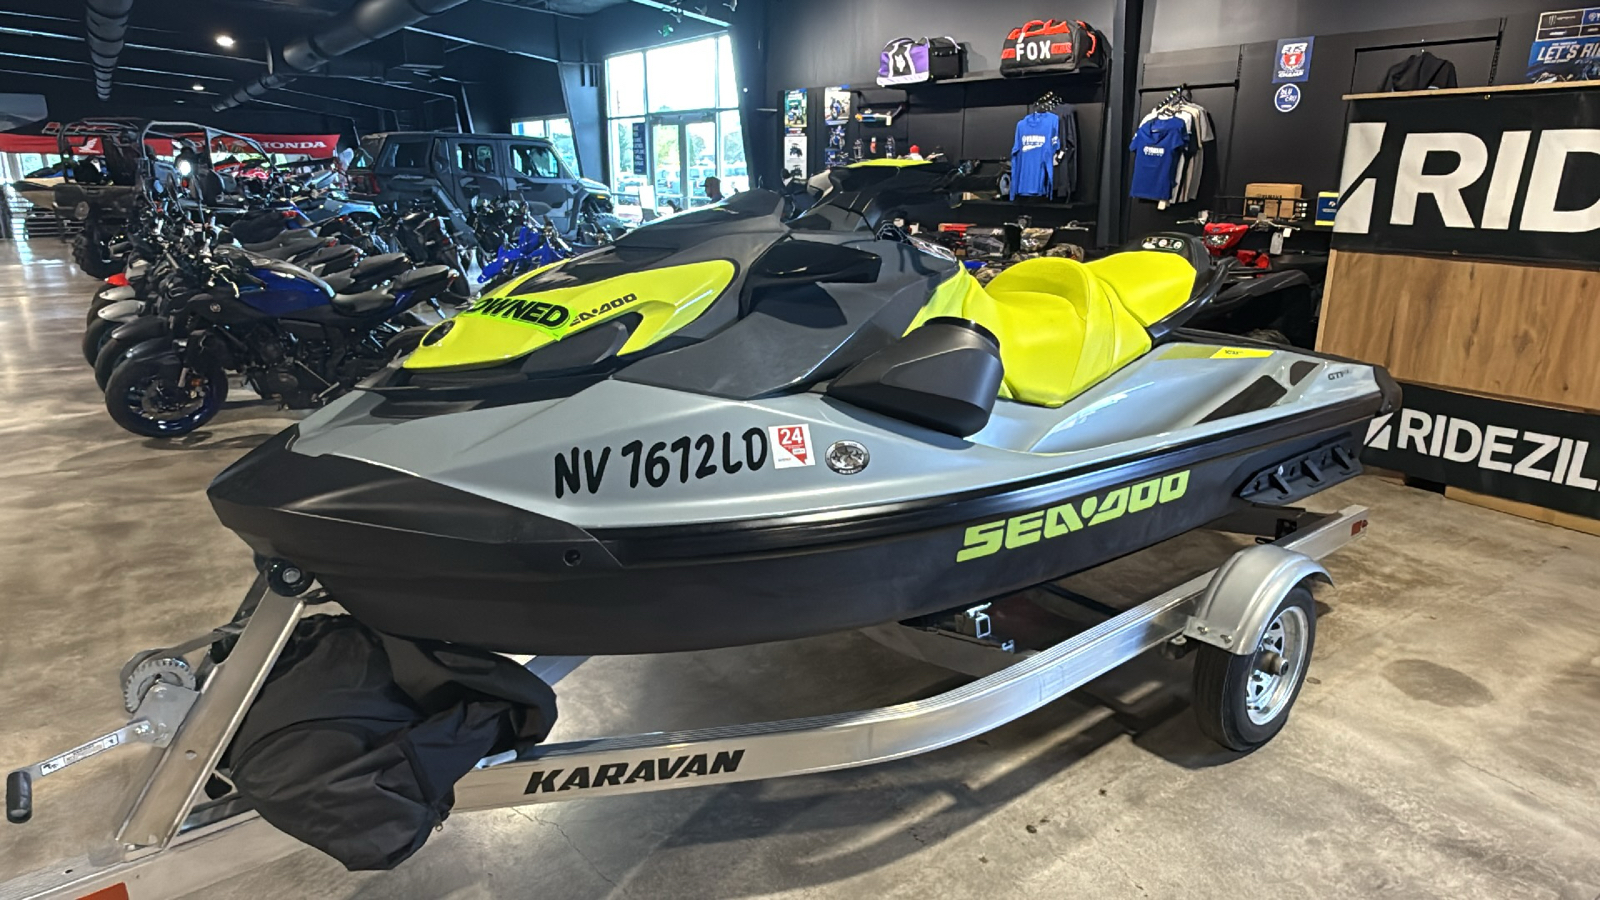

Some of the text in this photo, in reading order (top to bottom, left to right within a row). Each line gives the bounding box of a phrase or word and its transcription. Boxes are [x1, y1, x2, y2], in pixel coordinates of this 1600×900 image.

[1015, 39, 1051, 62] FOX
[1536, 42, 1600, 63] LET'S RI
[260, 140, 327, 149] HONDA
[1389, 128, 1600, 233] RID
[465, 297, 571, 329] OWNED
[780, 427, 803, 445] 24
[1396, 407, 1600, 492] RIDEZIL
[554, 446, 612, 499] NV
[524, 749, 746, 795] KARAVAN
